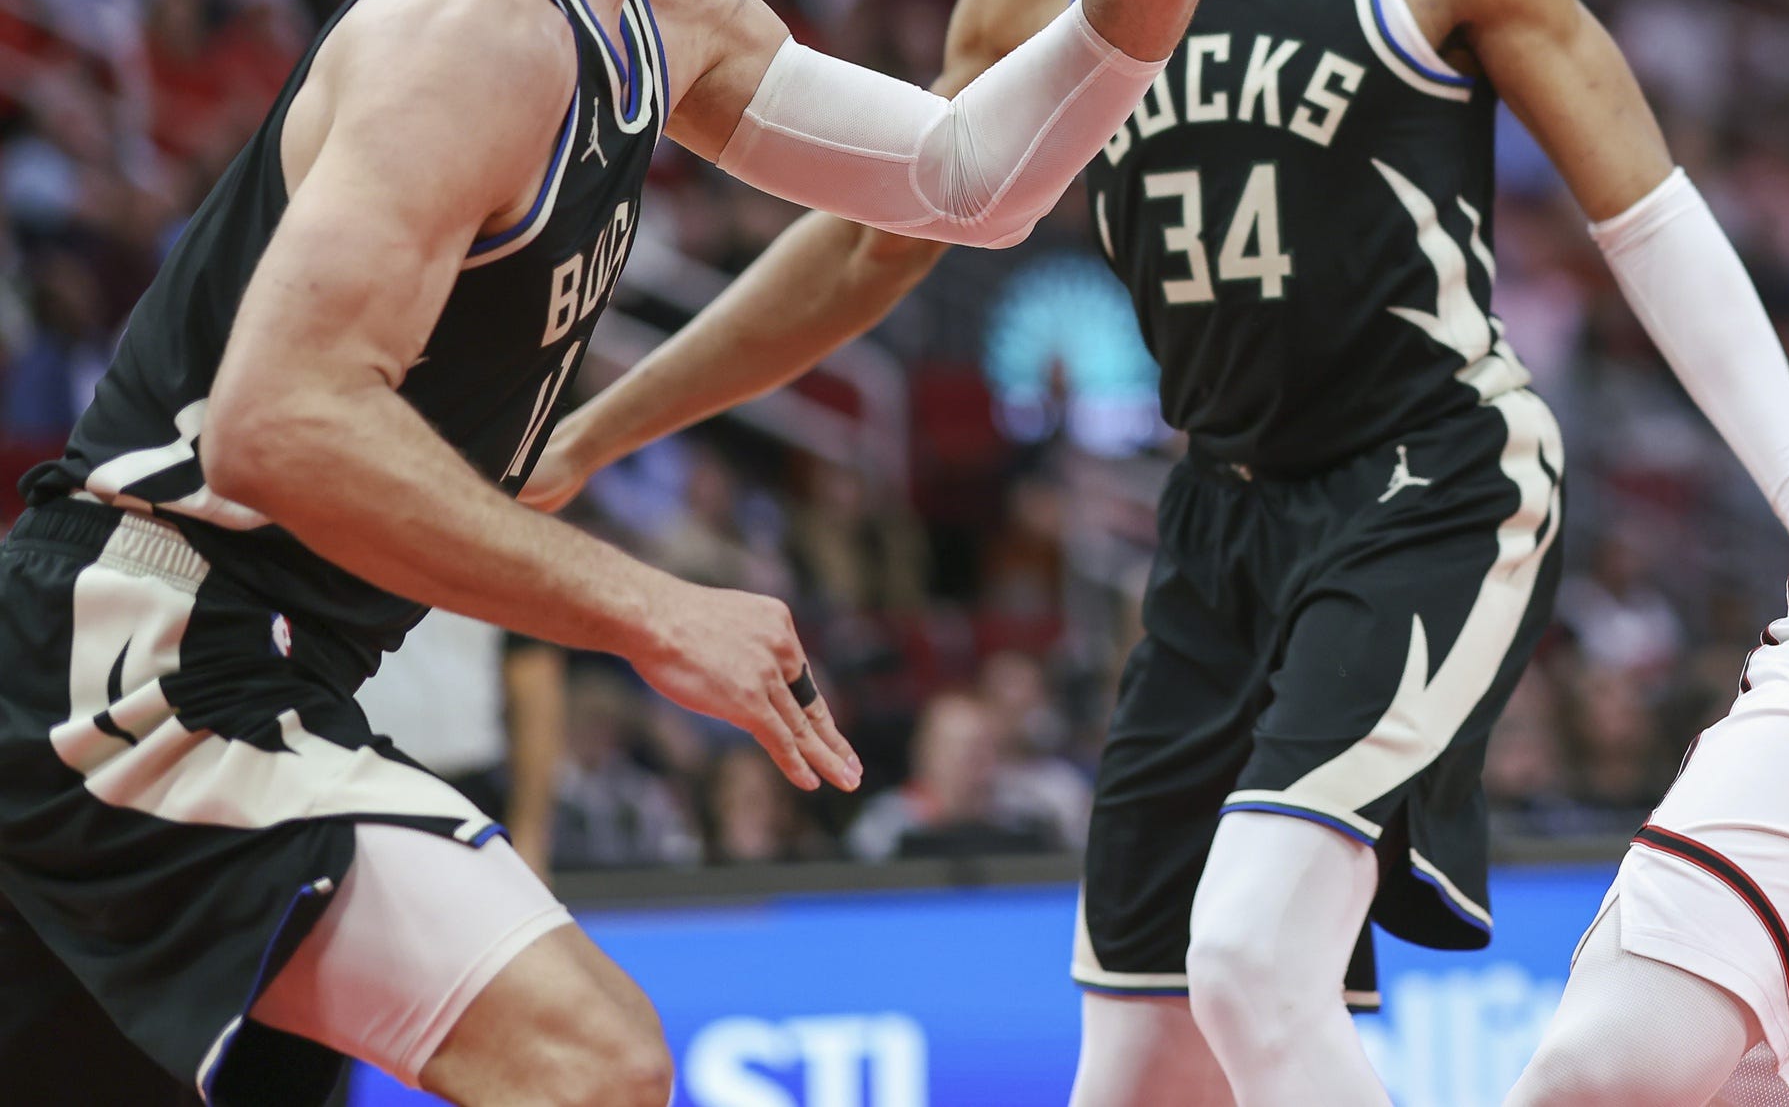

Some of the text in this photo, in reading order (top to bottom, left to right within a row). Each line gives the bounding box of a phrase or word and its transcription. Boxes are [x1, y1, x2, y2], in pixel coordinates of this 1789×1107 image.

[541, 201, 637, 347] BUC
[1143, 163, 1293, 305] 34
[500, 340, 581, 483] 11
